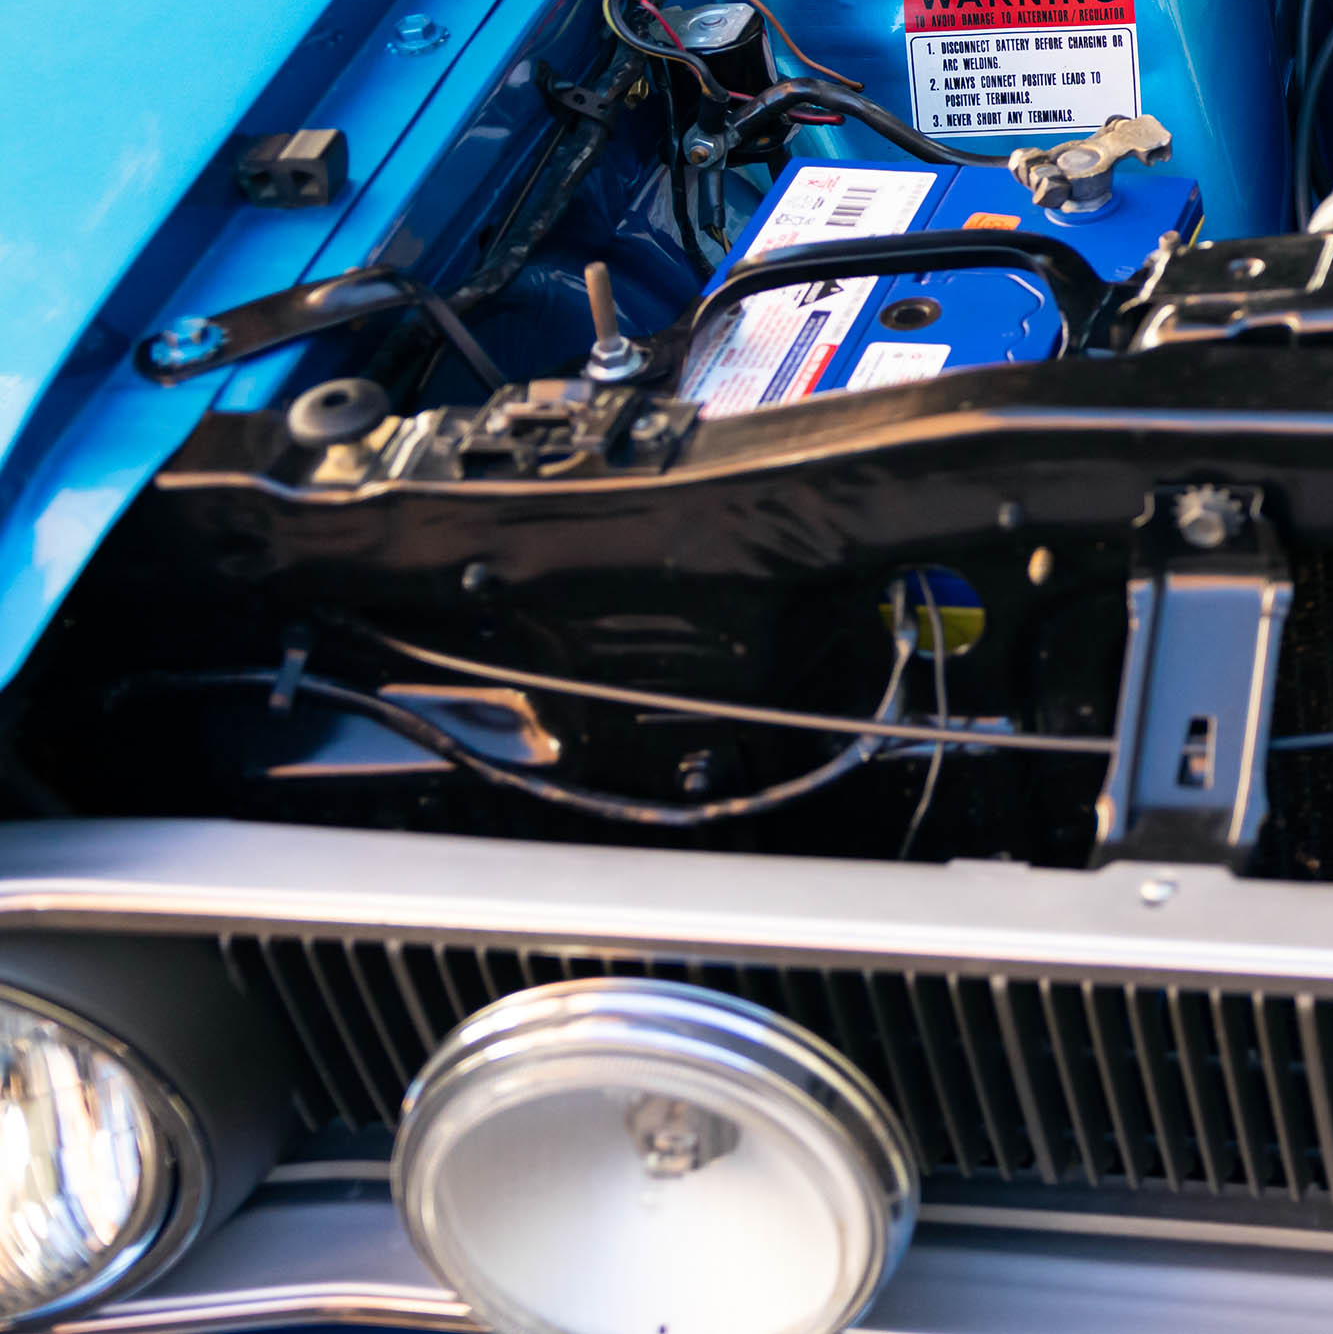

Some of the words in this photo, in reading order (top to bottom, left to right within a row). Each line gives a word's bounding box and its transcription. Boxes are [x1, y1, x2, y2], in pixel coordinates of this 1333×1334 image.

[915, 14, 925, 28] TO
[931, 13, 956, 28] AVOID
[962, 12, 995, 27] DAMAGE
[1001, 11, 1012, 25] TO
[1017, 9, 1069, 24] ALTERNATOR
[1079, 7, 1125, 21] REGULATOR
[927, 42, 936, 55] 1.
[940, 39, 990, 55] DISCONNECT
[995, 38, 1030, 52] BATTERY
[1034, 36, 1063, 50] BEFORE
[1067, 34, 1107, 49] CHARGING
[1112, 33, 1123, 48] OR
[942, 58, 958, 72] ARC
[963, 55, 1002, 71] WELDING.
[929, 77, 940, 92] 2.
[944, 75, 976, 90] ALWAYS
[980, 73, 1017, 88] CONNECT
[1021, 72, 1057, 87] POSITIVE
[1061, 71, 1086, 86] LEADS
[1090, 70, 1101, 84] TO
[945, 92, 981, 108] POSITIVE
[985, 90, 1033, 106] TERMINALS.
[932, 114, 943, 128] 3.
[946, 112, 972, 127] NEVER
[976, 111, 1002, 126] SHORT
[1007, 109, 1023, 125] ANY
[1027, 108, 1075, 124] TERMINALS.
